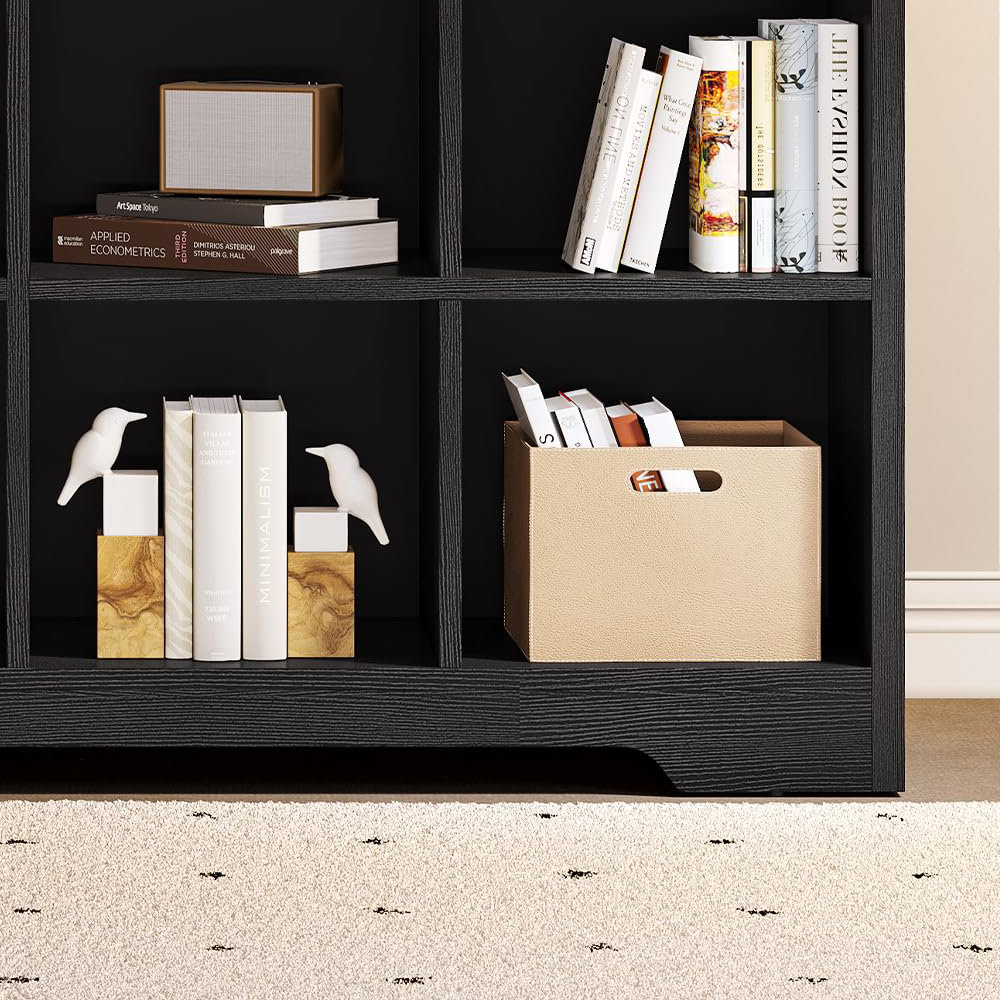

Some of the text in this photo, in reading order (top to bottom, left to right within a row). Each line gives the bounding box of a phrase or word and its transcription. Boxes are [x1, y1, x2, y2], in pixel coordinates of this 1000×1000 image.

[116, 201, 126, 210] Art
[126, 202, 142, 212] Space
[90, 231, 131, 243] APPLIED
[90, 244, 166, 259] ECONOMETRICS
[193, 241, 256, 252] DIMITRIOS ASTERIOU
[193, 250, 246, 260] STEPHEN G. HALL
[259, 466, 273, 604] MINIMALISM
